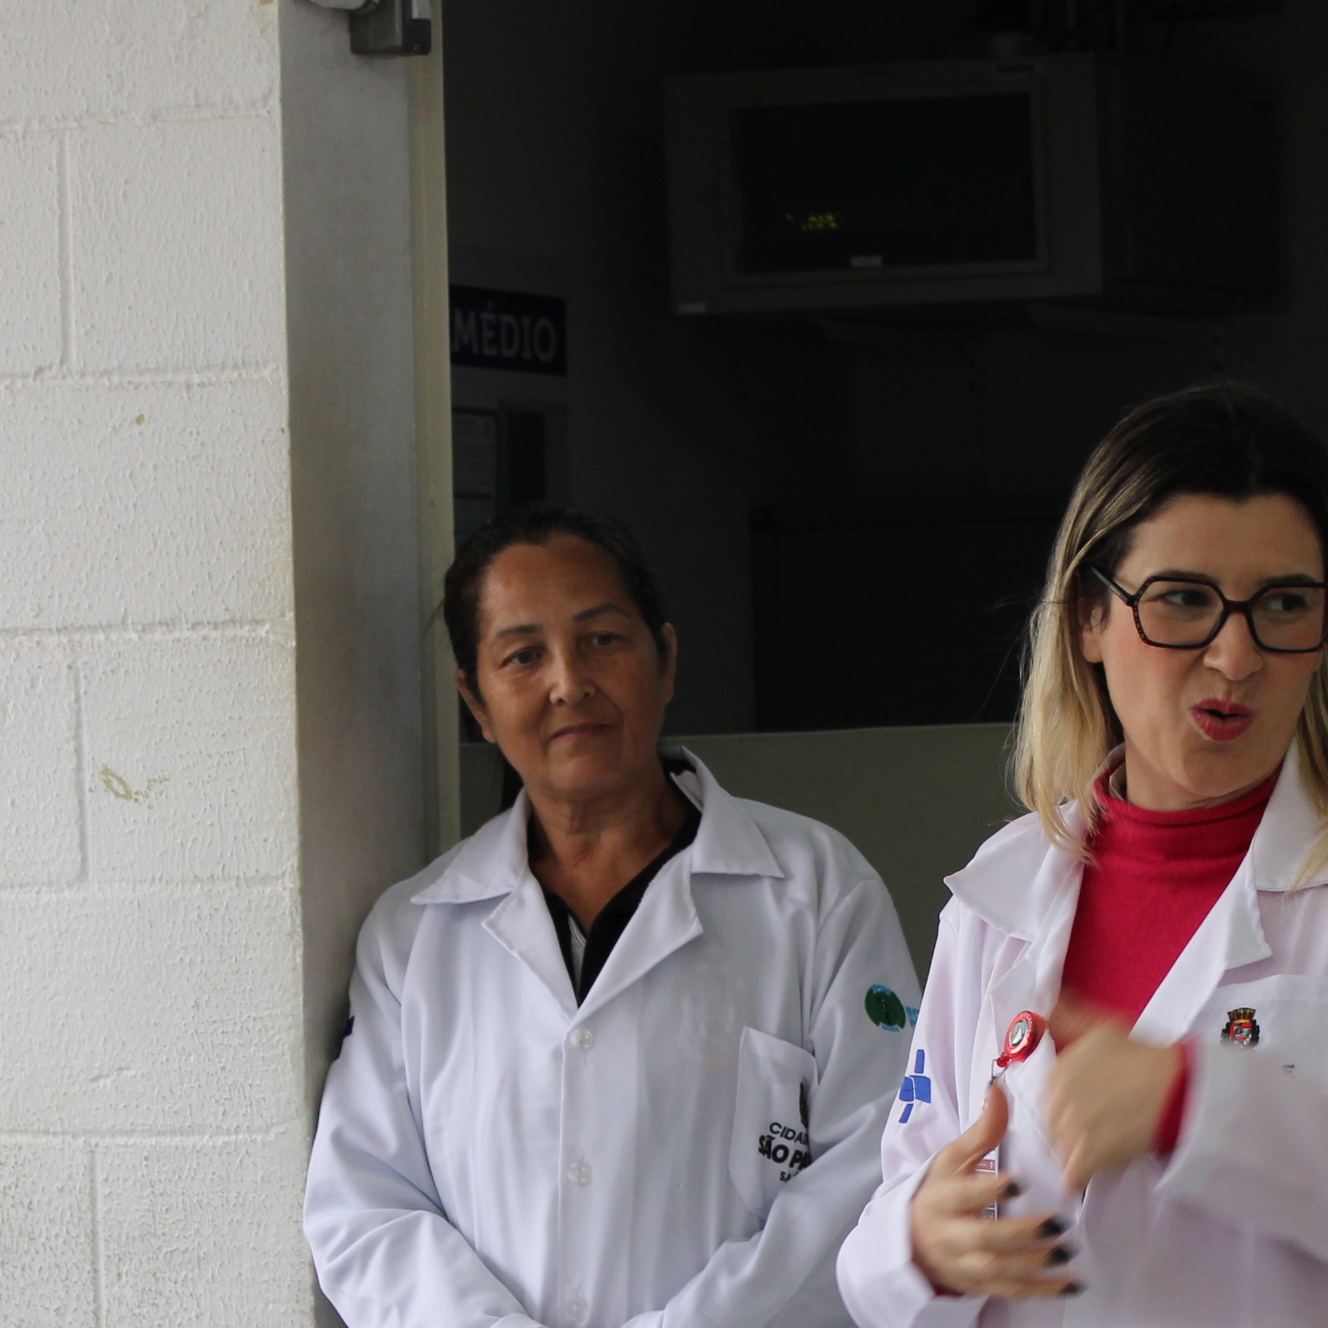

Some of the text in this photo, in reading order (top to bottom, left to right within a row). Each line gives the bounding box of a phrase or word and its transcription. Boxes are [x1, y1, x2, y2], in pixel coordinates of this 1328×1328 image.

[452, 300, 558, 362] MÉDIO
[758, 1134, 812, 1171] SÃO PA
